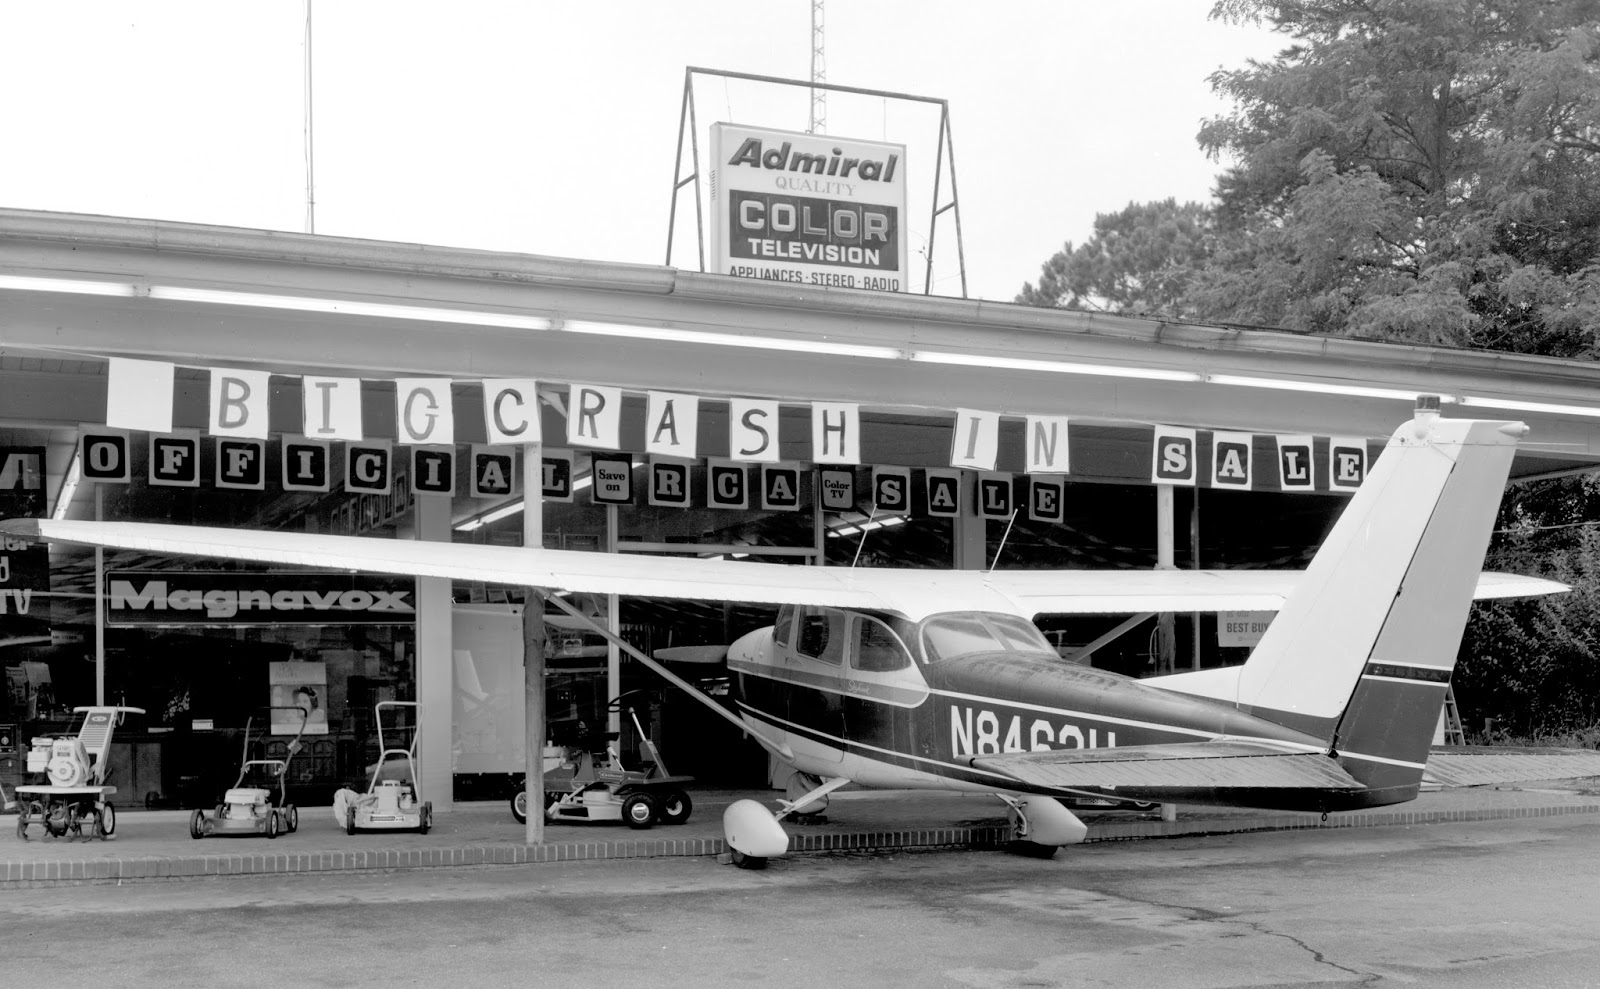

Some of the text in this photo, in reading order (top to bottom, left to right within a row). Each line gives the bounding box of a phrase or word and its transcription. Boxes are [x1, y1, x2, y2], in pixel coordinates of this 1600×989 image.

[728, 137, 898, 182] Admiral
[775, 176, 857, 196] QUALITY
[740, 200, 888, 242] COLOR
[748, 238, 880, 265] TELEVISION
[729, 265, 899, 292] APPLIANCES STEREO RADIO
[218, 377, 1360, 481] BIG CRASH IN SALE
[90, 442, 1056, 513] OFFICIAL RCA SALE
[598, 468, 626, 481] Save
[605, 484, 620, 492] on
[824, 479, 850, 490] Color
[830, 490, 845, 499] TV
[110, 580, 414, 618] Magnavox
[1226, 622, 1249, 633] BEST
